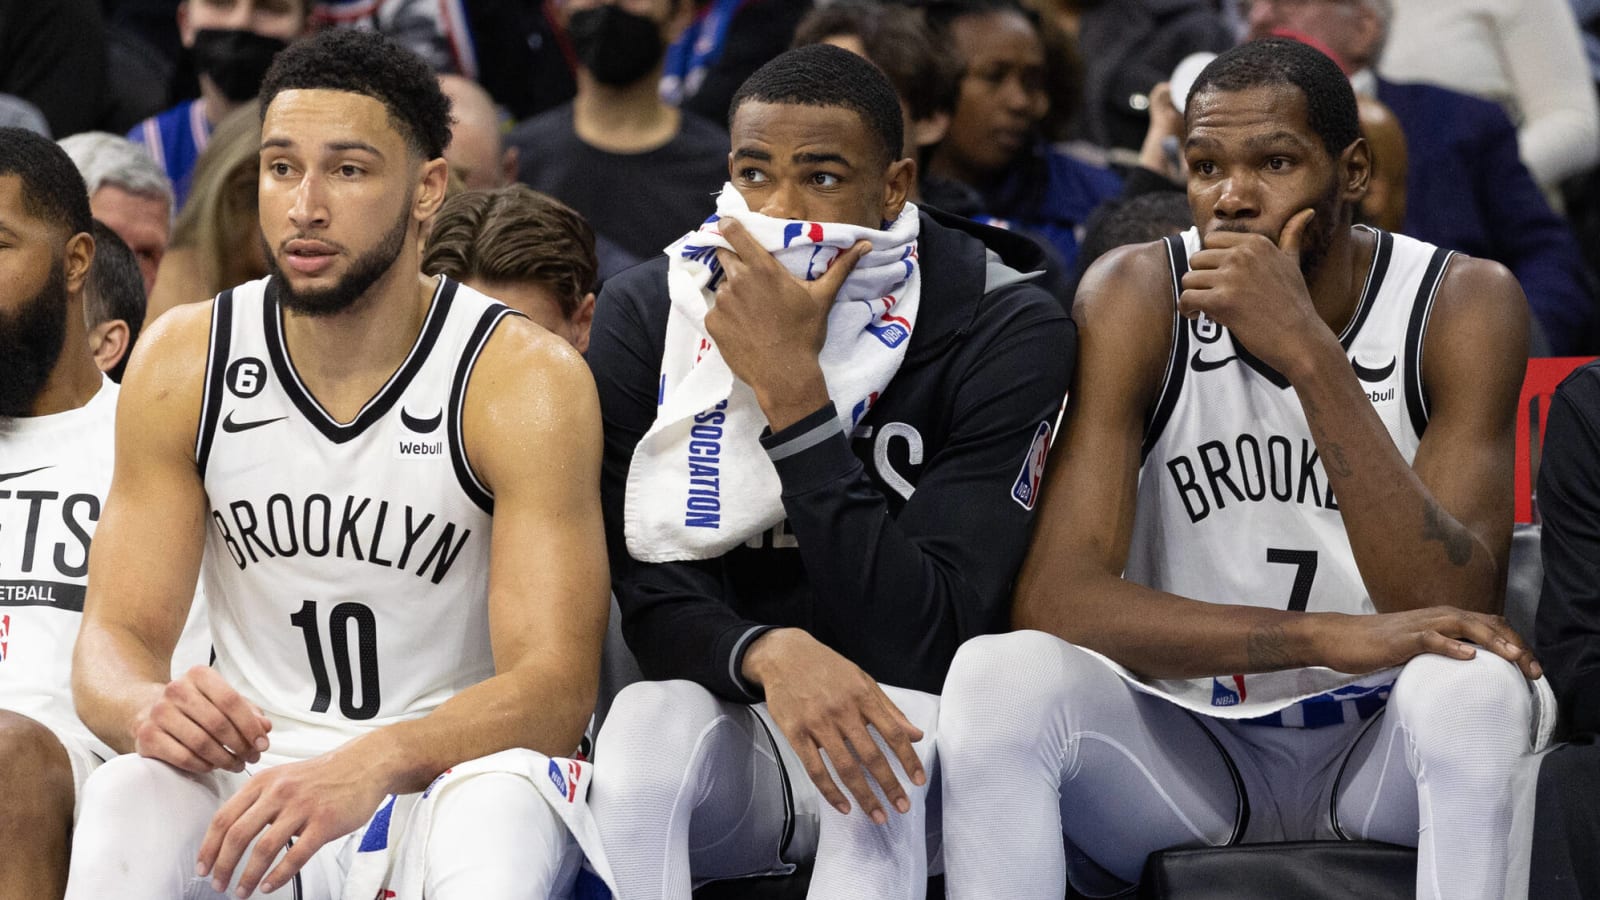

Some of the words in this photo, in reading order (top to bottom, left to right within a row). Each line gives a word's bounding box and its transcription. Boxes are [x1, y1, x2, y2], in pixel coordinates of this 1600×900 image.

[234, 363, 260, 393] 6
[399, 441, 443, 455] Webull
[0, 490, 101, 578] TS
[212, 493, 471, 585] BROOKLYN
[1266, 547, 1319, 613] 7
[290, 599, 381, 720] 10
[1214, 695, 1236, 706] NBA
